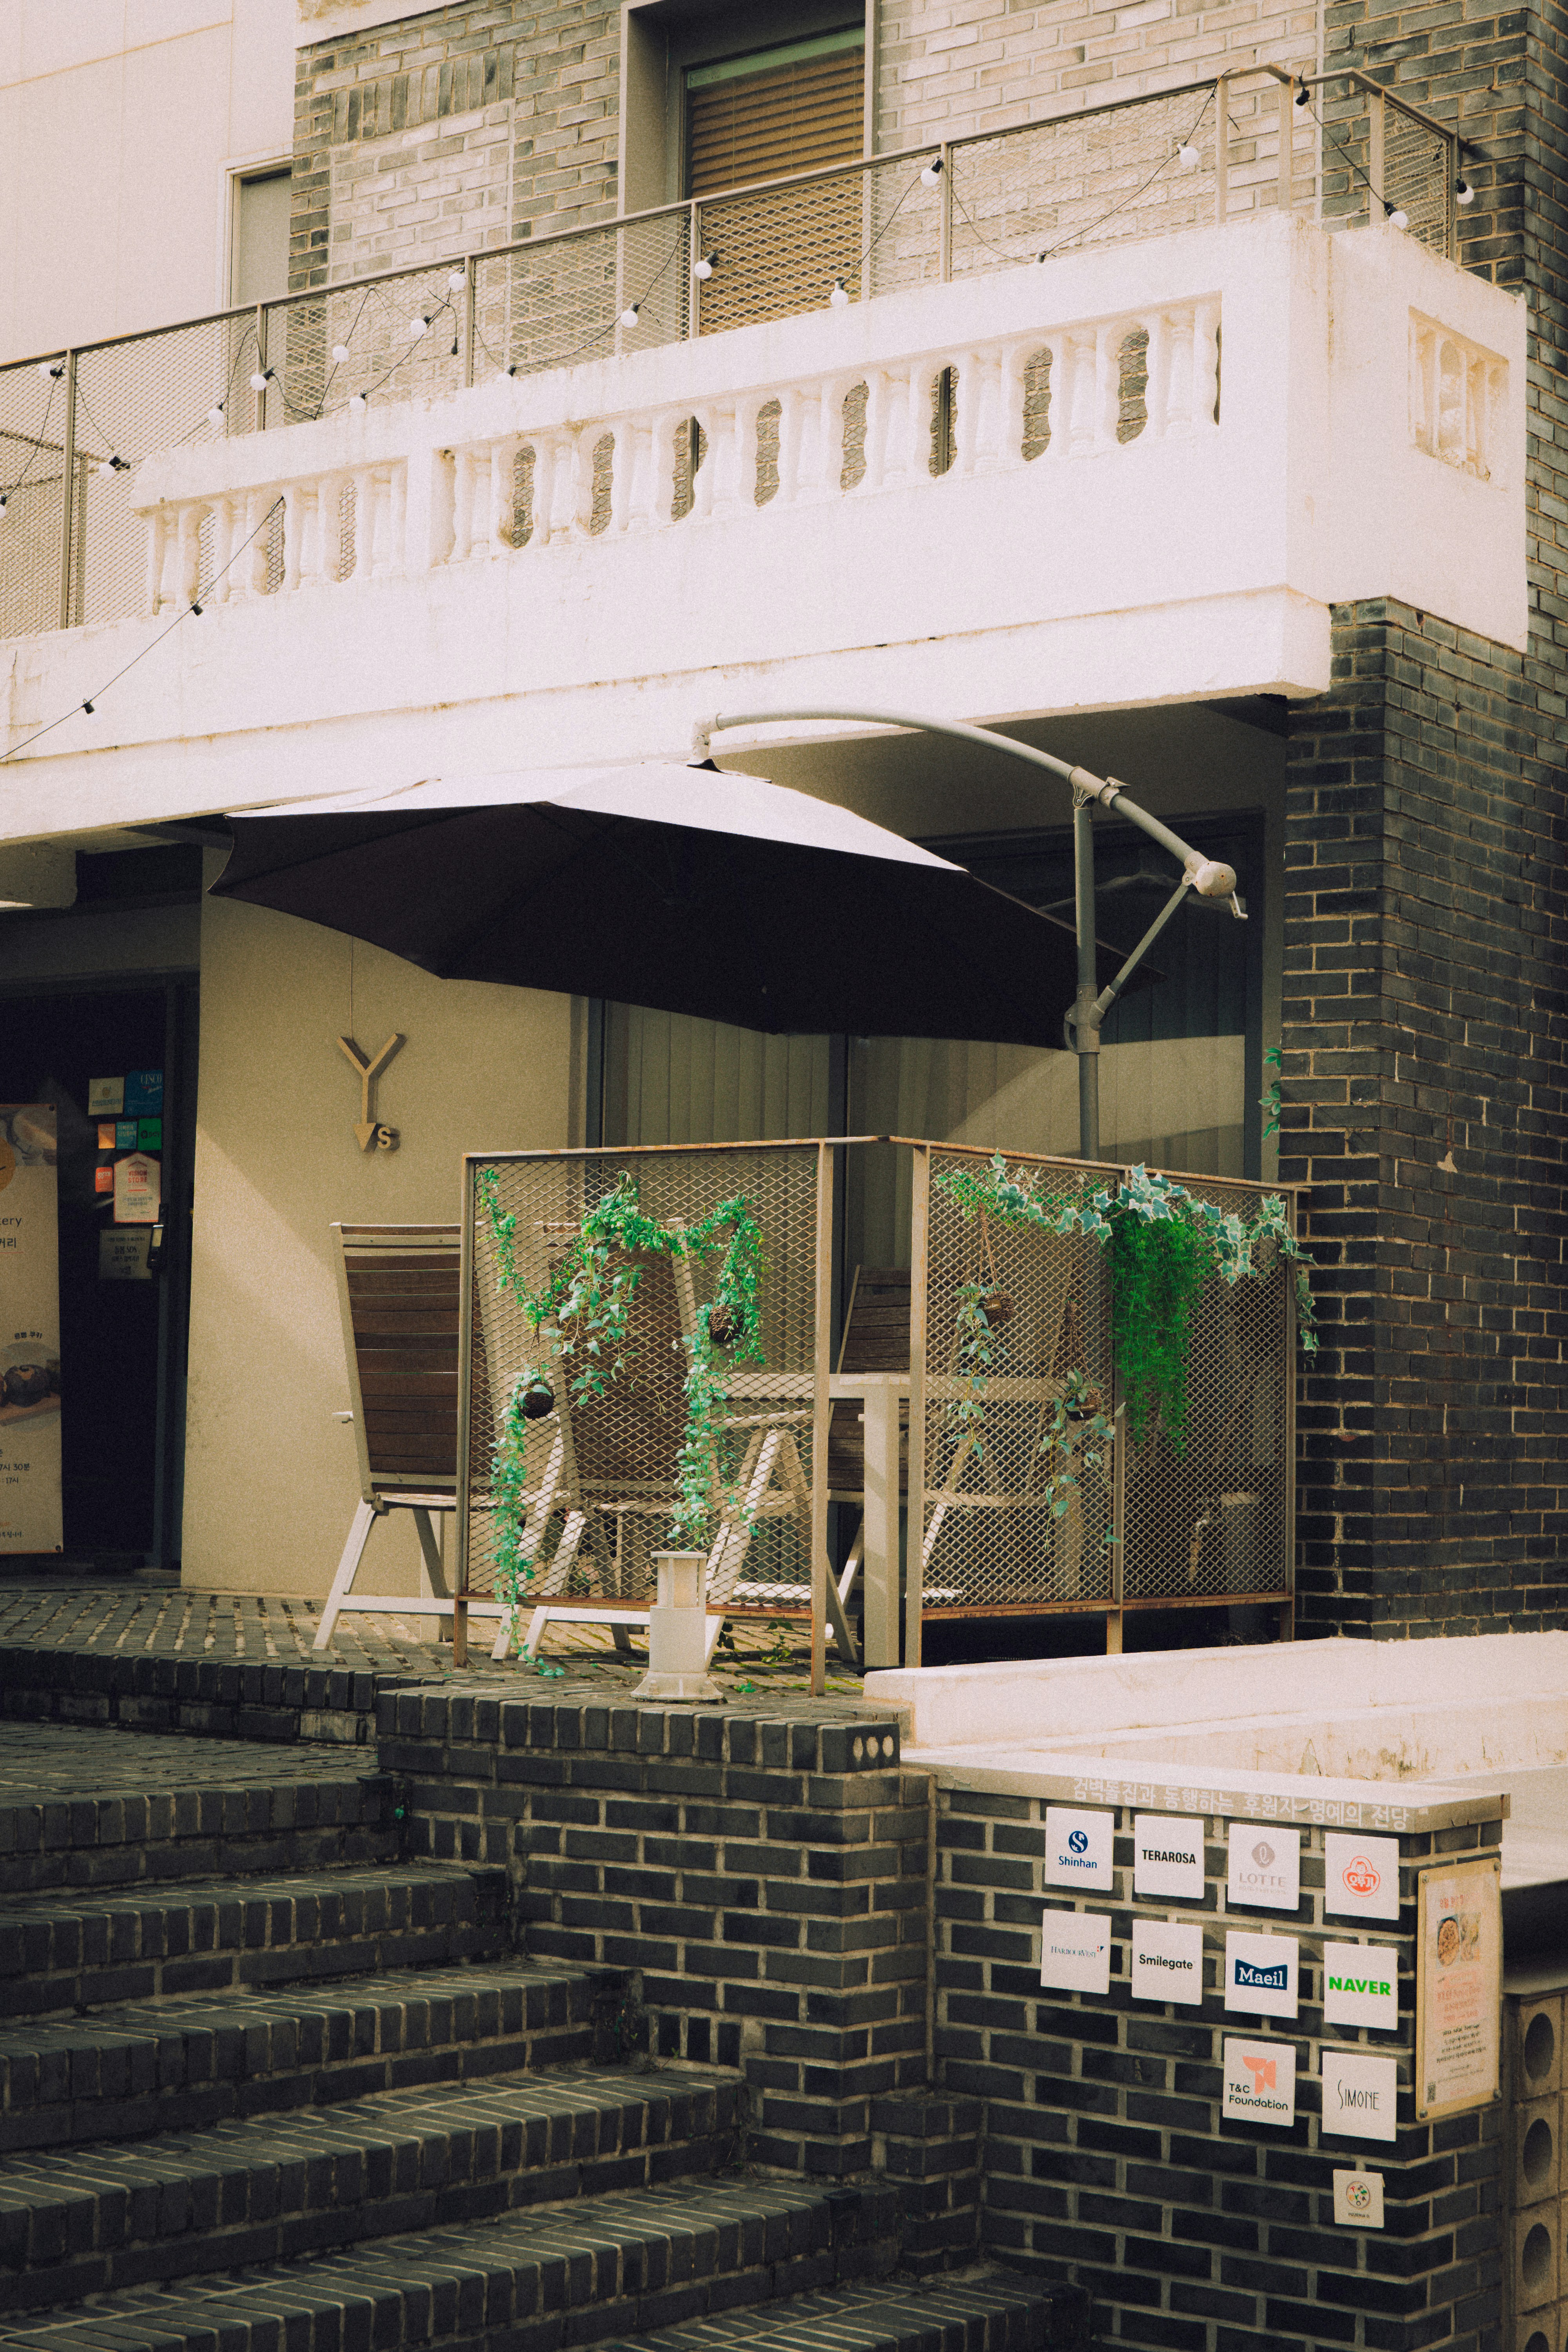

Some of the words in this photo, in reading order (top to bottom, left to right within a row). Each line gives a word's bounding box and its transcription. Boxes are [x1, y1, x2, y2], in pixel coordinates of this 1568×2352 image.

[140, 1073, 162, 1085] CESCO
[0, 1218, 22, 1227] ery
[13, 1463, 31, 1471] 30분
[1073, 1777, 1156, 1809] 검벽돌집과
[1163, 1786, 1234, 1816] 동행하는
[1243, 1793, 1298, 1820] 후원자
[1309, 1800, 1363, 1827] 명예의
[1371, 1805, 1411, 1831] 전당
[1058, 1856, 1097, 1869] Shinhan
[1142, 1849, 1196, 1864] TERAROSA
[1239, 1873, 1287, 1888] LOTTE
[1349, 1875, 1374, 1889] 오뚜기
[1139, 1954, 1193, 1970] Smilegate
[1239, 1967, 1284, 1986] Maeil
[1329, 1976, 1391, 1996] NAVER
[1229, 2083, 1250, 2093] T&C
[1229, 2094, 1288, 2110] Foundation
